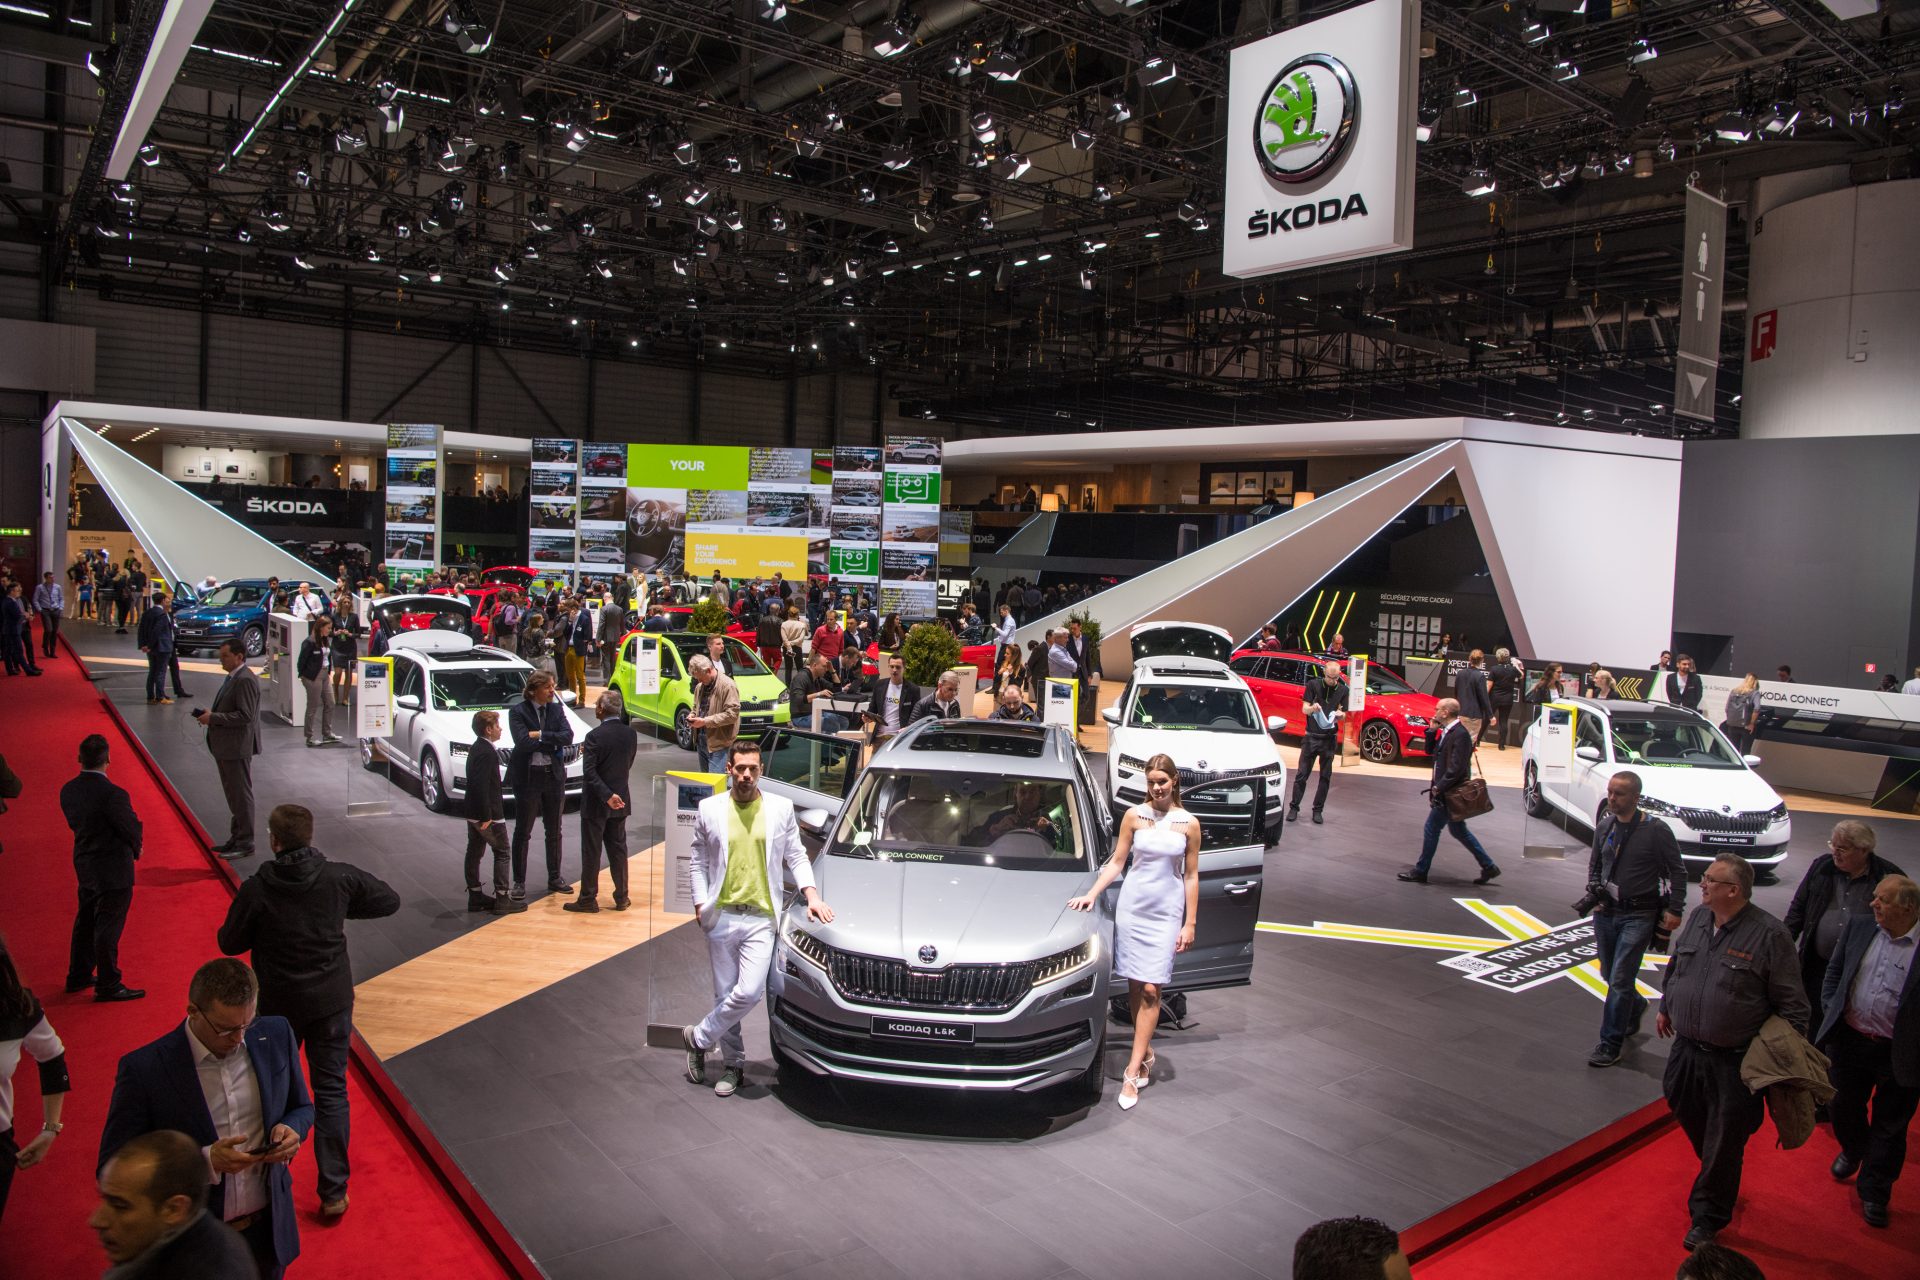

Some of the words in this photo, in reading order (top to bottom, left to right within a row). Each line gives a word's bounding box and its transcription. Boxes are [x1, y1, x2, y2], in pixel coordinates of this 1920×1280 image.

[1248, 193, 1368, 239] ŠKODA
[1757, 315, 1772, 348] F
[670, 460, 705, 471] YOUR
[247, 497, 327, 514] ŠKODA
[694, 557, 737, 566] EXPERIENCE
[1411, 595, 1429, 603] VOTRE
[1429, 596, 1453, 605] CADEAU
[1759, 691, 1788, 702] KODA
[1790, 694, 1840, 707] CONNECT
[677, 813, 700, 821] KODIA
[904, 852, 944, 861] CONNECT
[1487, 947, 1531, 962] TRY
[1520, 937, 1566, 952] THE
[1492, 951, 1581, 983] CHATBOT
[888, 1023, 931, 1035] KODIAQ
[934, 1027, 957, 1036] L&K
